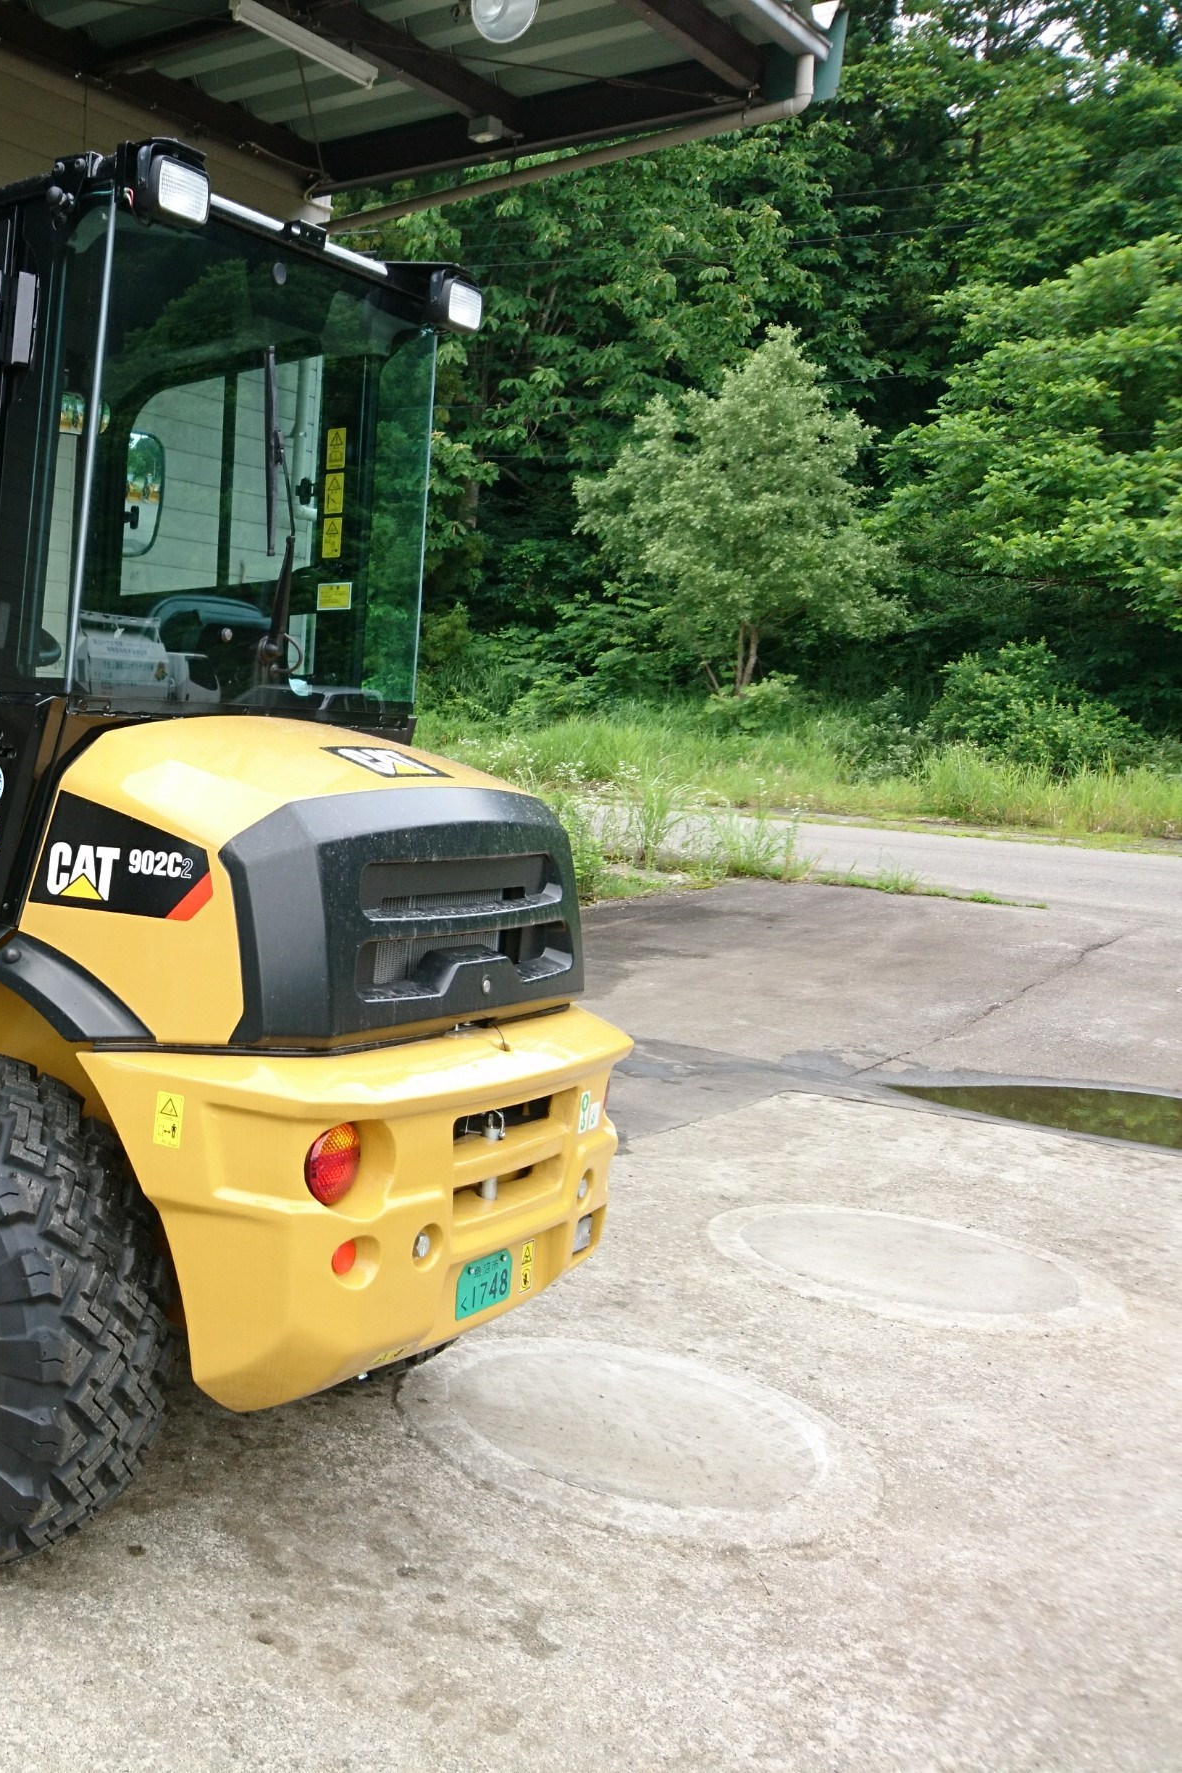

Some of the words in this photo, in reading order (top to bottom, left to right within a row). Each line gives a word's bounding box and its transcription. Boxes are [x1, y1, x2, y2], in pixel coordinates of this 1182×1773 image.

[337, 748, 439, 776] CAT
[46, 841, 121, 901] CAT
[128, 848, 194, 879] 902C2
[471, 1268, 509, 1309] 1748
